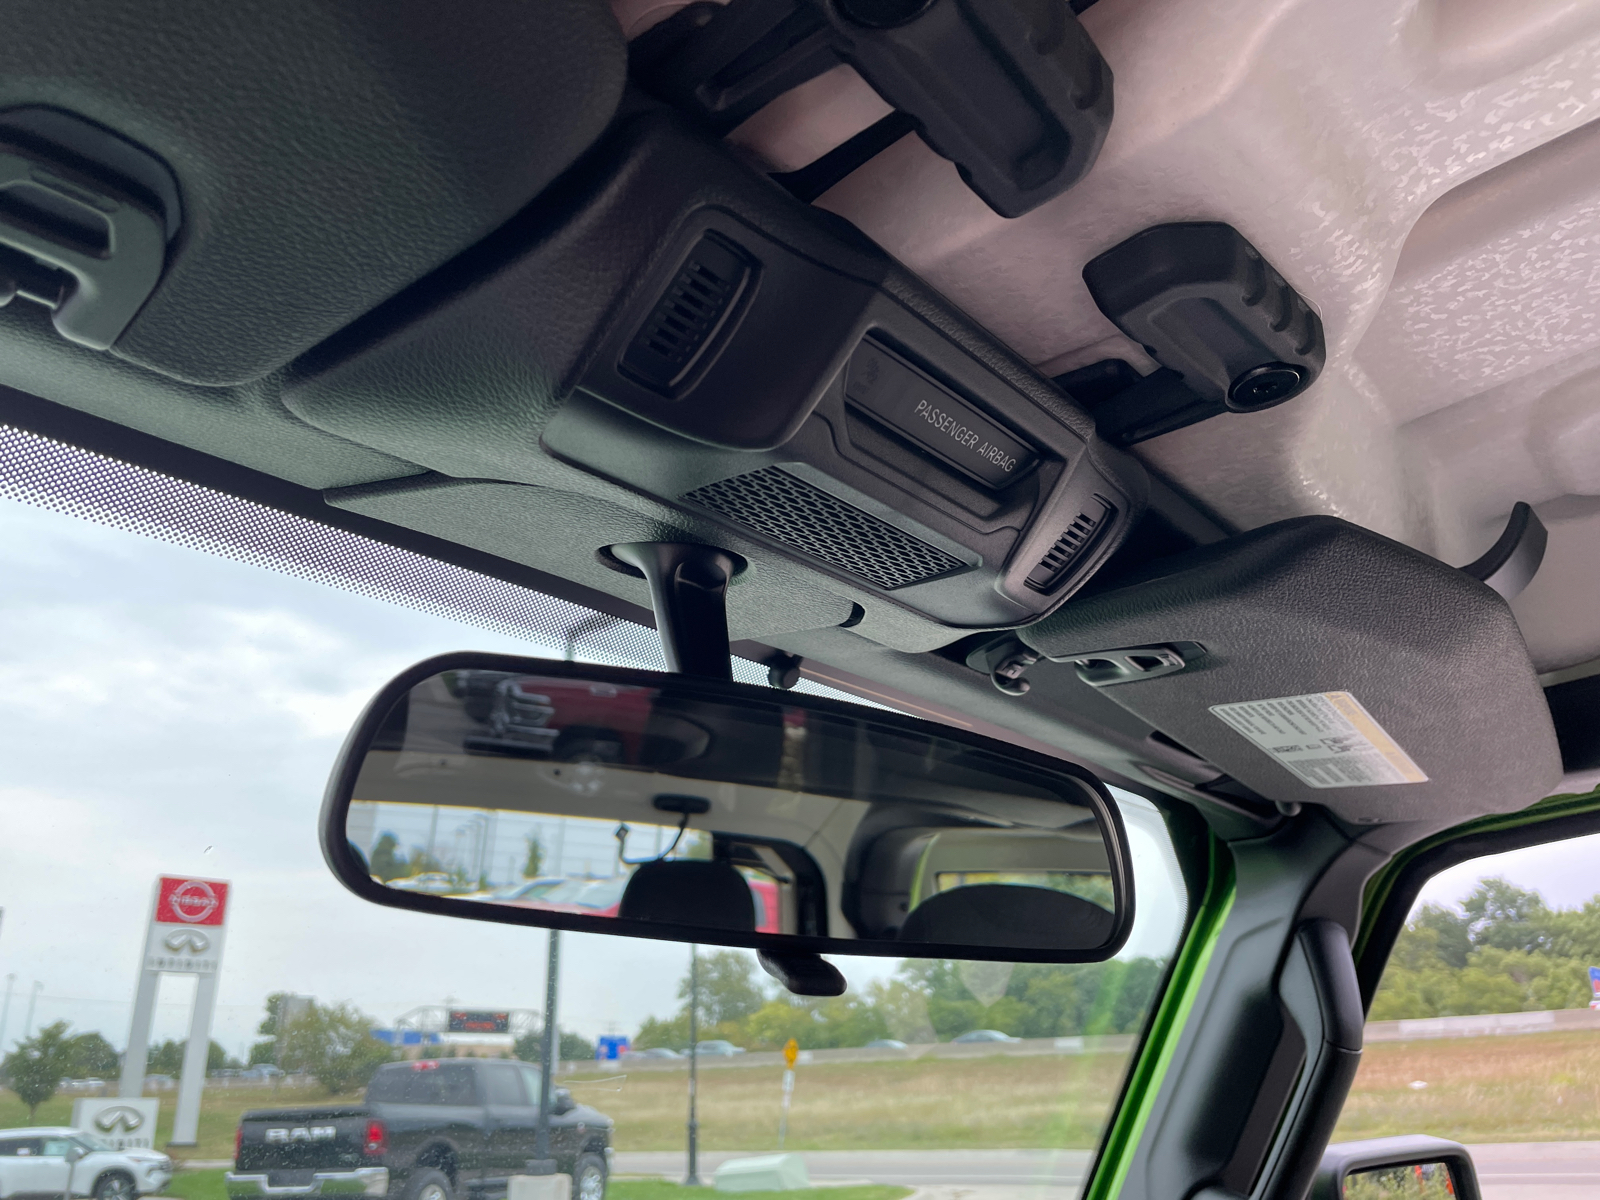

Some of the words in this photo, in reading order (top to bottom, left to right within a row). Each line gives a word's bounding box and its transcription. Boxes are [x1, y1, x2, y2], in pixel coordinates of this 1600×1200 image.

[914, 399, 979, 449] PASSENGER
[976, 441, 1017, 472] AIRBAG
[265, 1125, 337, 1143] RAM
